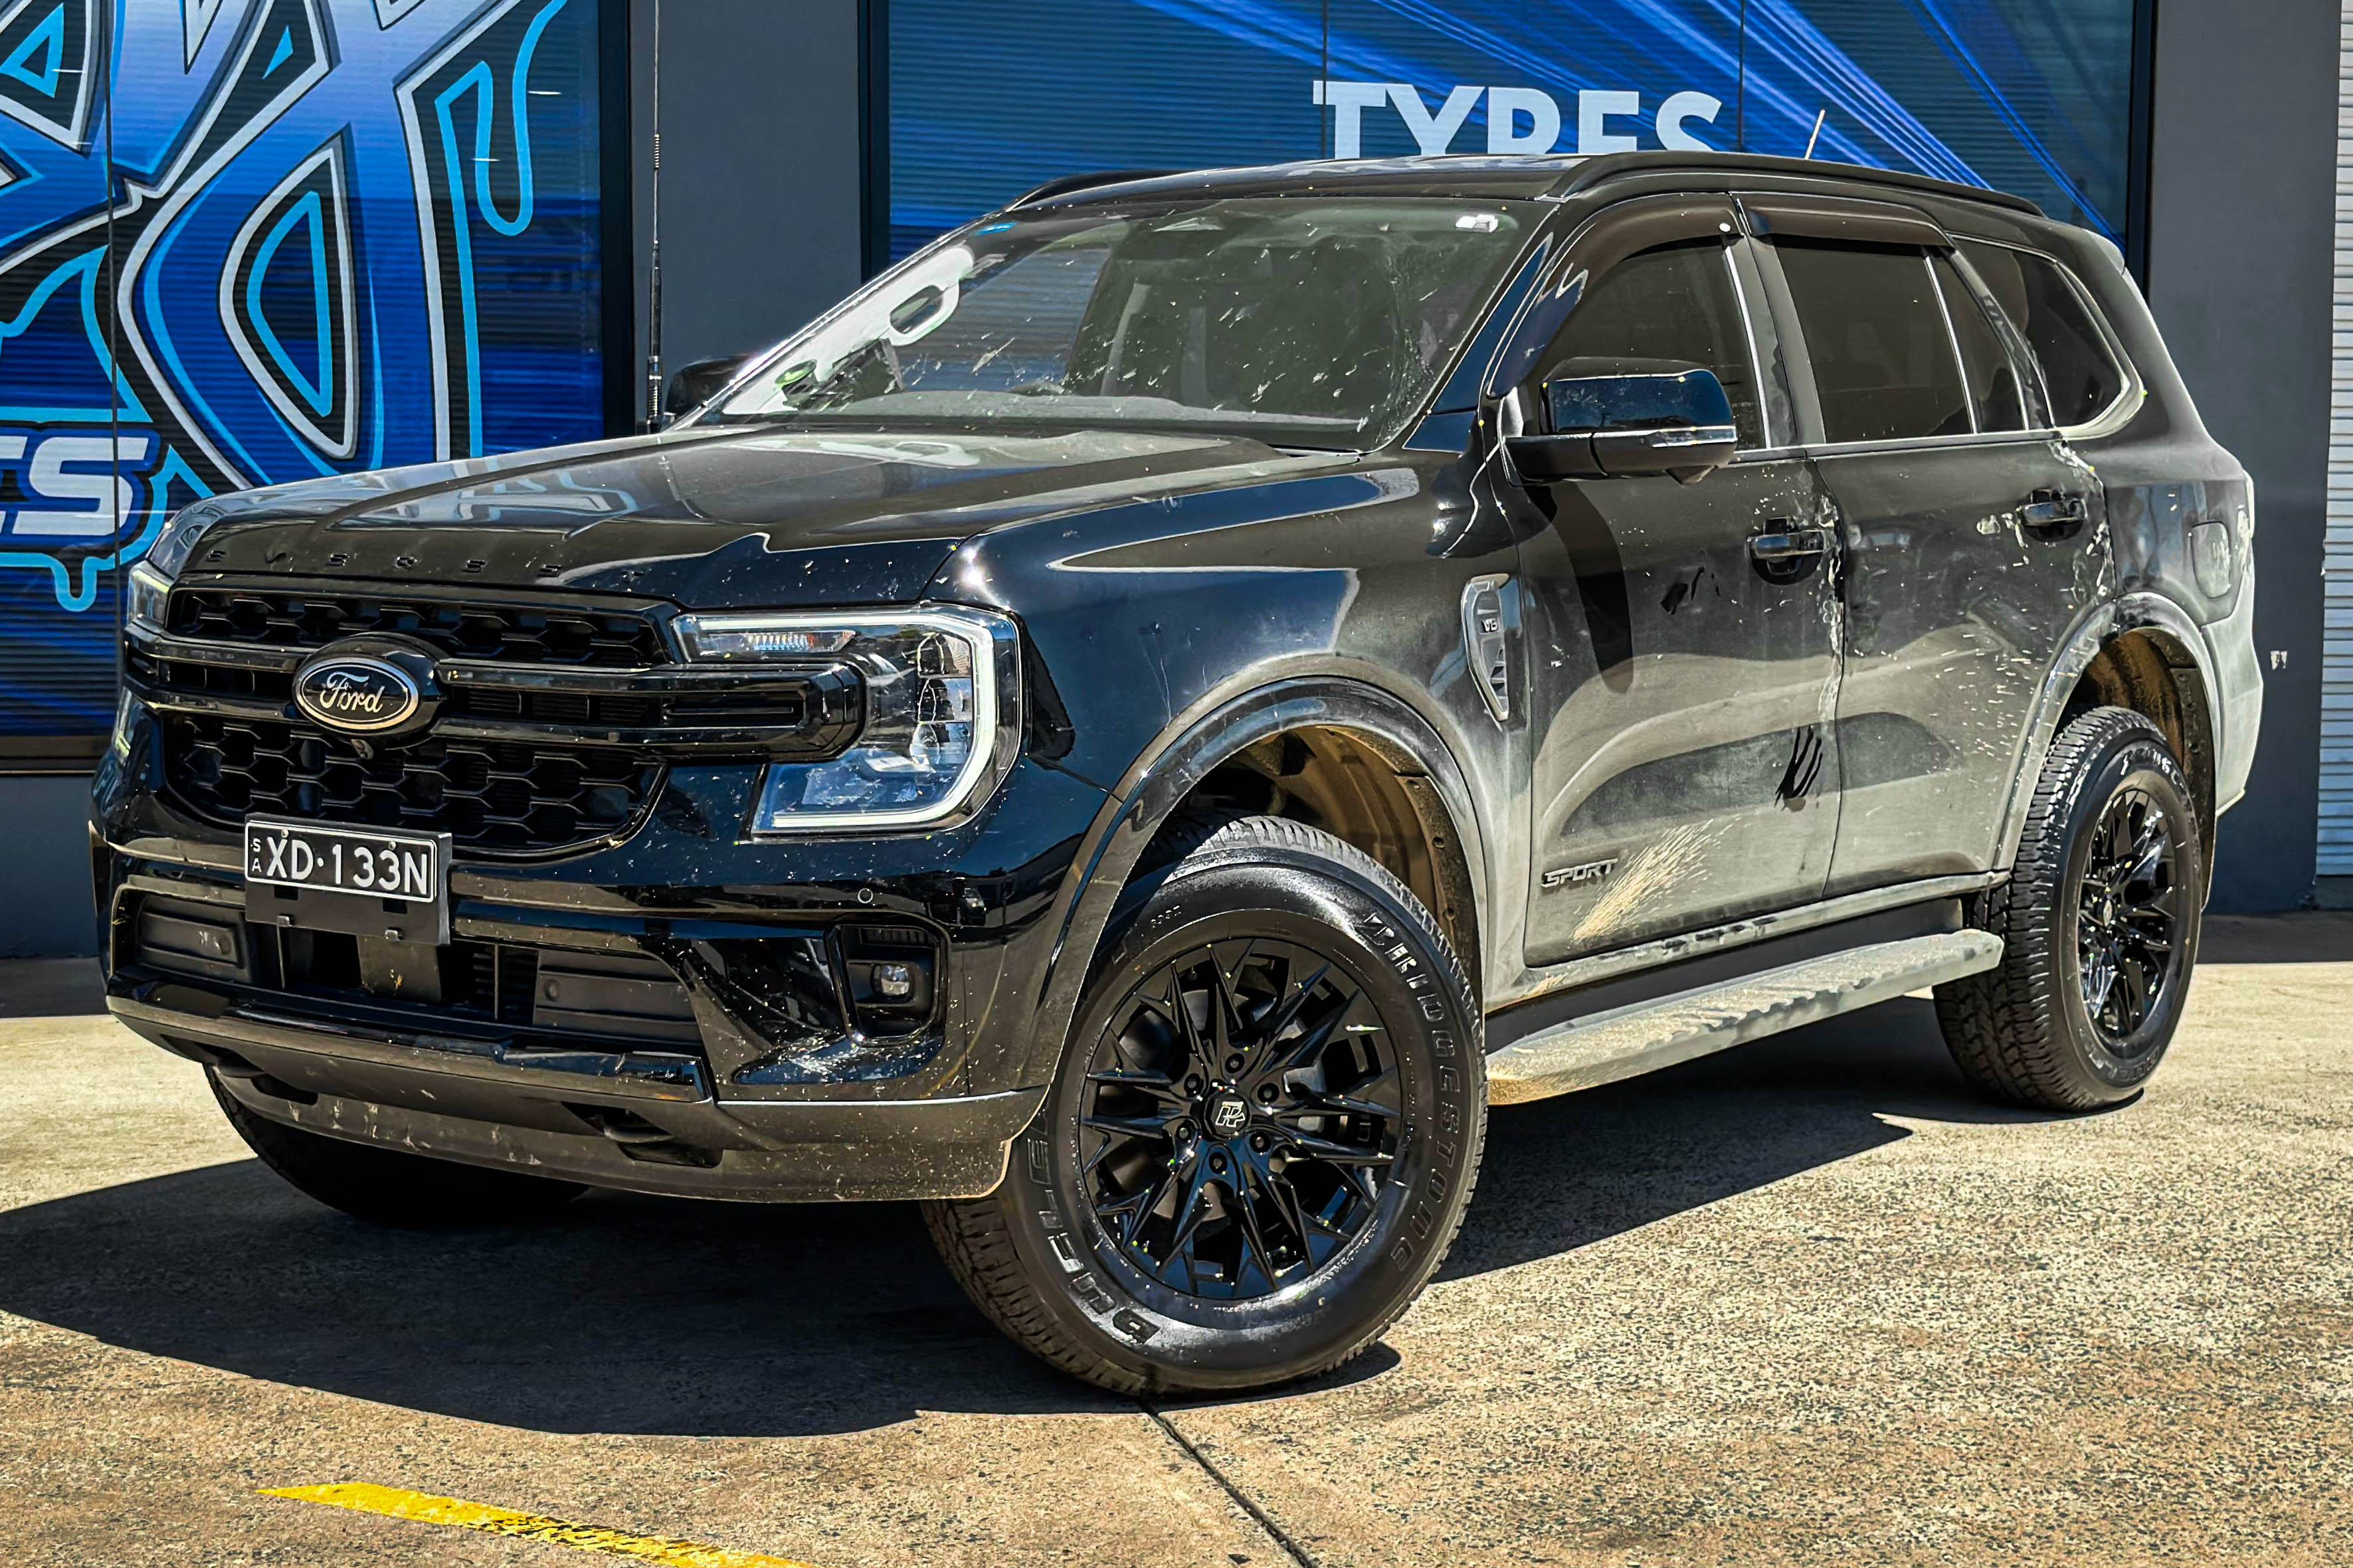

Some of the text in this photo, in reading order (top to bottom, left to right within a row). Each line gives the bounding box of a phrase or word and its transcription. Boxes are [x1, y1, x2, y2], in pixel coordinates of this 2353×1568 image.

[1313, 80, 1721, 160] TYRES
[320, 671, 385, 713] Ford
[1541, 858, 1618, 888] SPORT
[1353, 912, 1461, 1271] BRIDGESTONE
